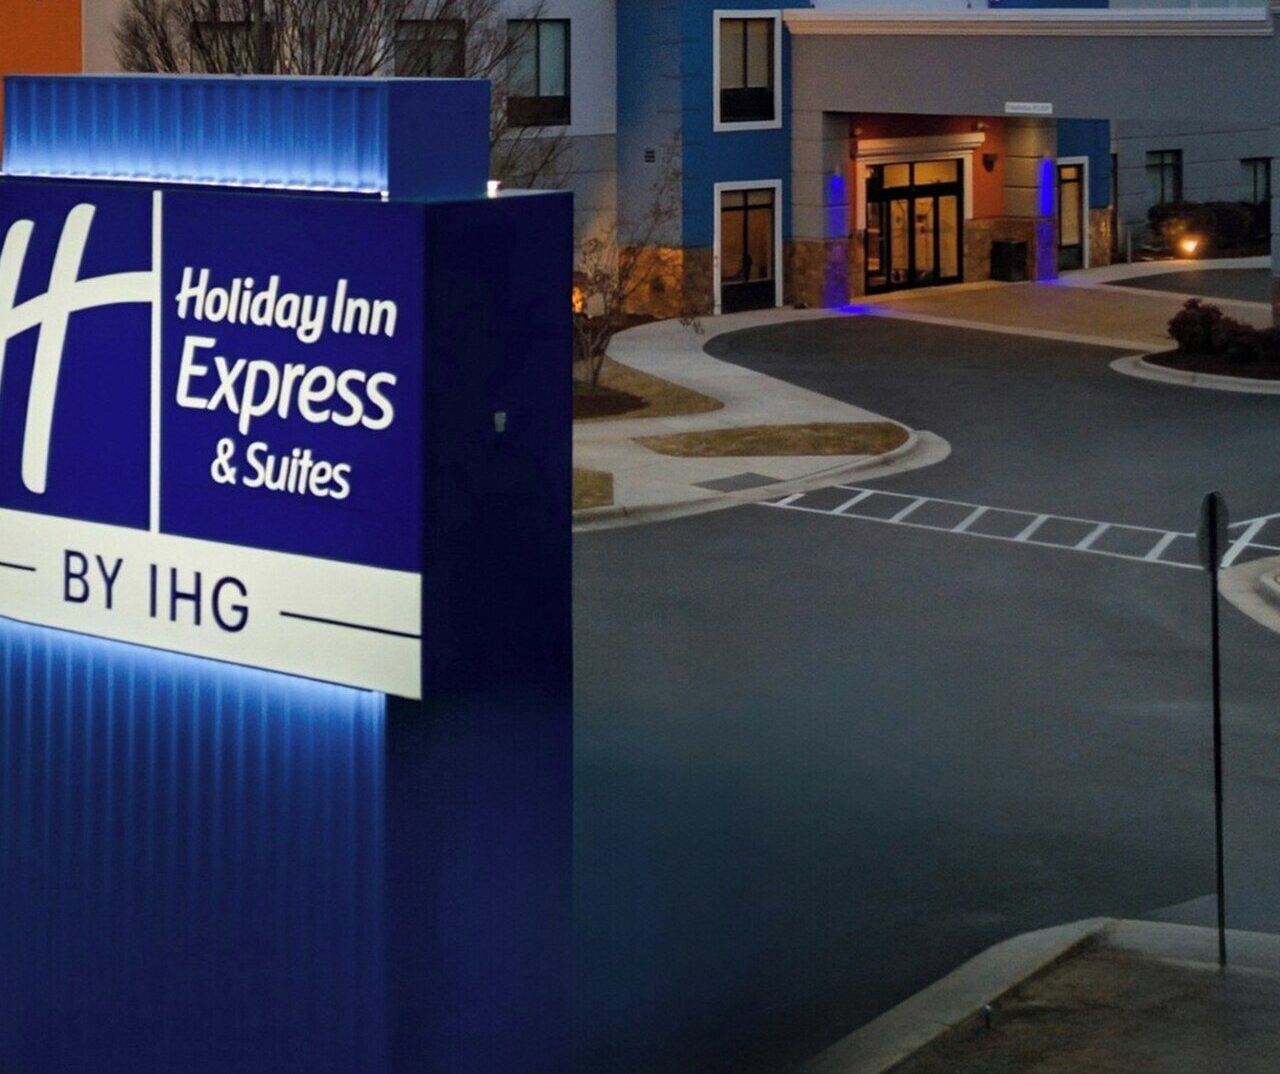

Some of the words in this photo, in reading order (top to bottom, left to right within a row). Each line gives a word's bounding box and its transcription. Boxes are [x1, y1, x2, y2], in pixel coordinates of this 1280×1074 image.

[175, 266, 329, 344] Holiday
[331, 278, 397, 337] Inn
[175, 335, 398, 436] Express
[210, 437, 237, 485] &
[242, 441, 351, 500] Suites
[63, 548, 124, 610] BY
[149, 563, 250, 633] IHG
